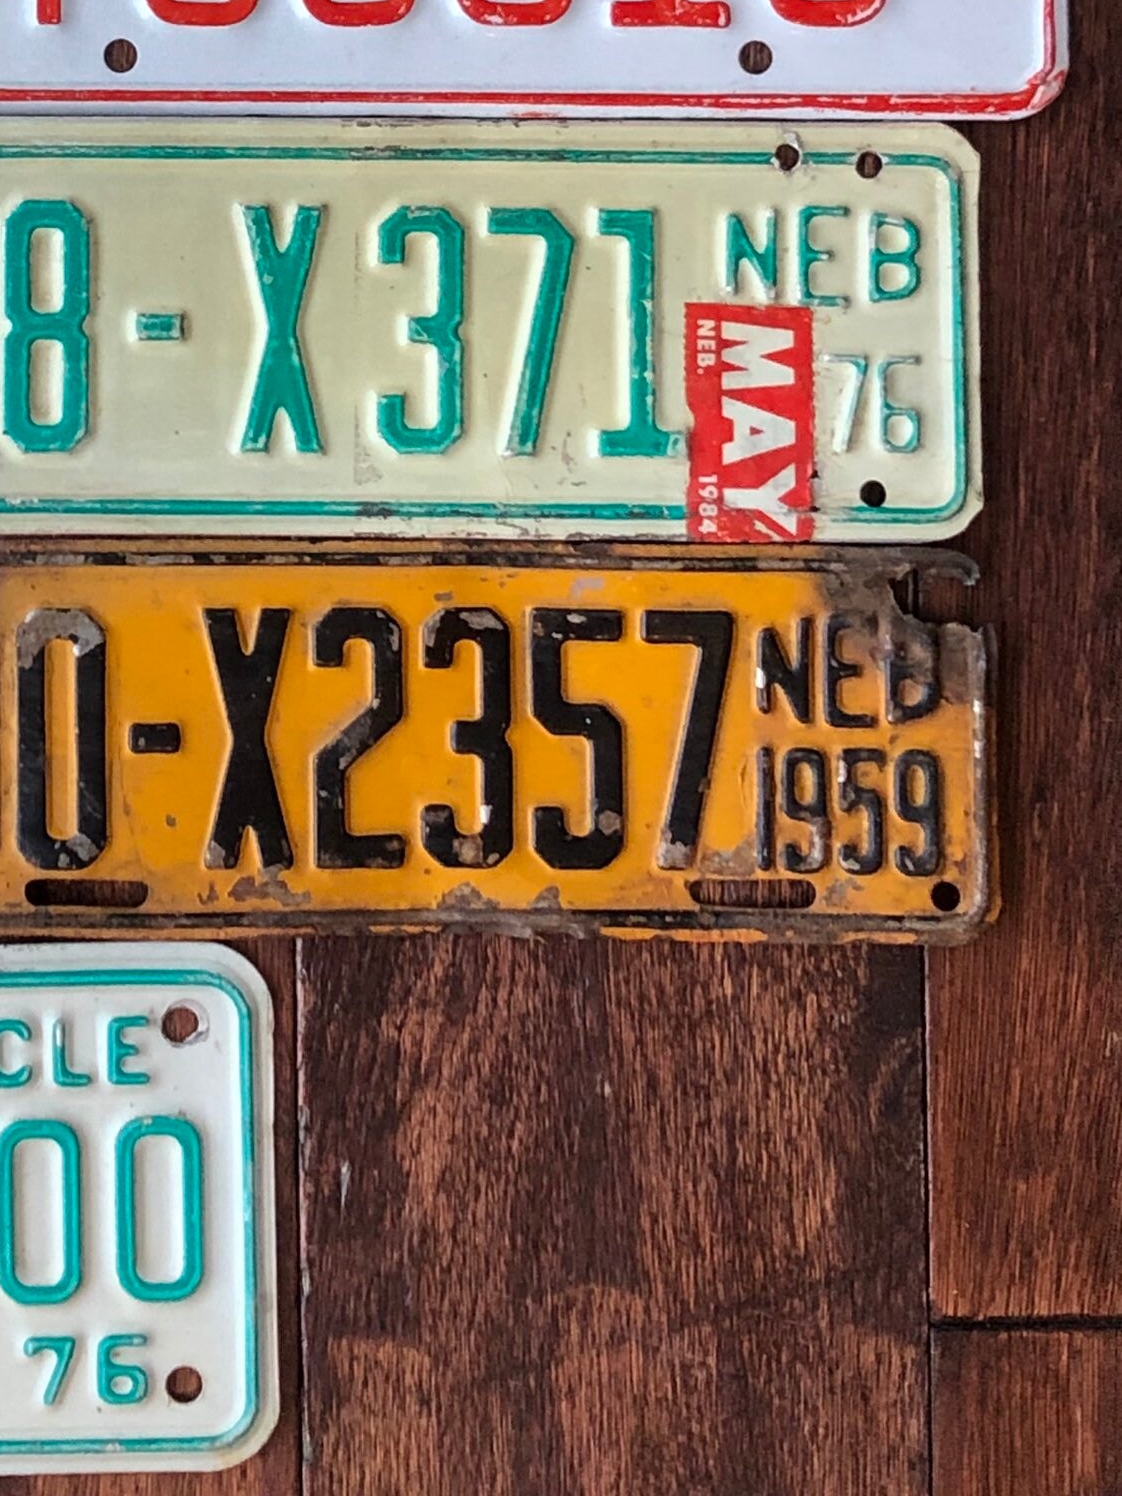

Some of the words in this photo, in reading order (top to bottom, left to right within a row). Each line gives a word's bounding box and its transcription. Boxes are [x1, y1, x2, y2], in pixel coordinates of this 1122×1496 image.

[724, 205, 922, 307] NEB
[696, 319, 716, 375] NEB.
[720, 320, 797, 537] MAY
[821, 354, 921, 454] 76
[698, 474, 718, 534] 1984
[755, 613, 942, 729] NEB
[756, 745, 942, 877] 1959
[23, 1333, 149, 1406] 76
